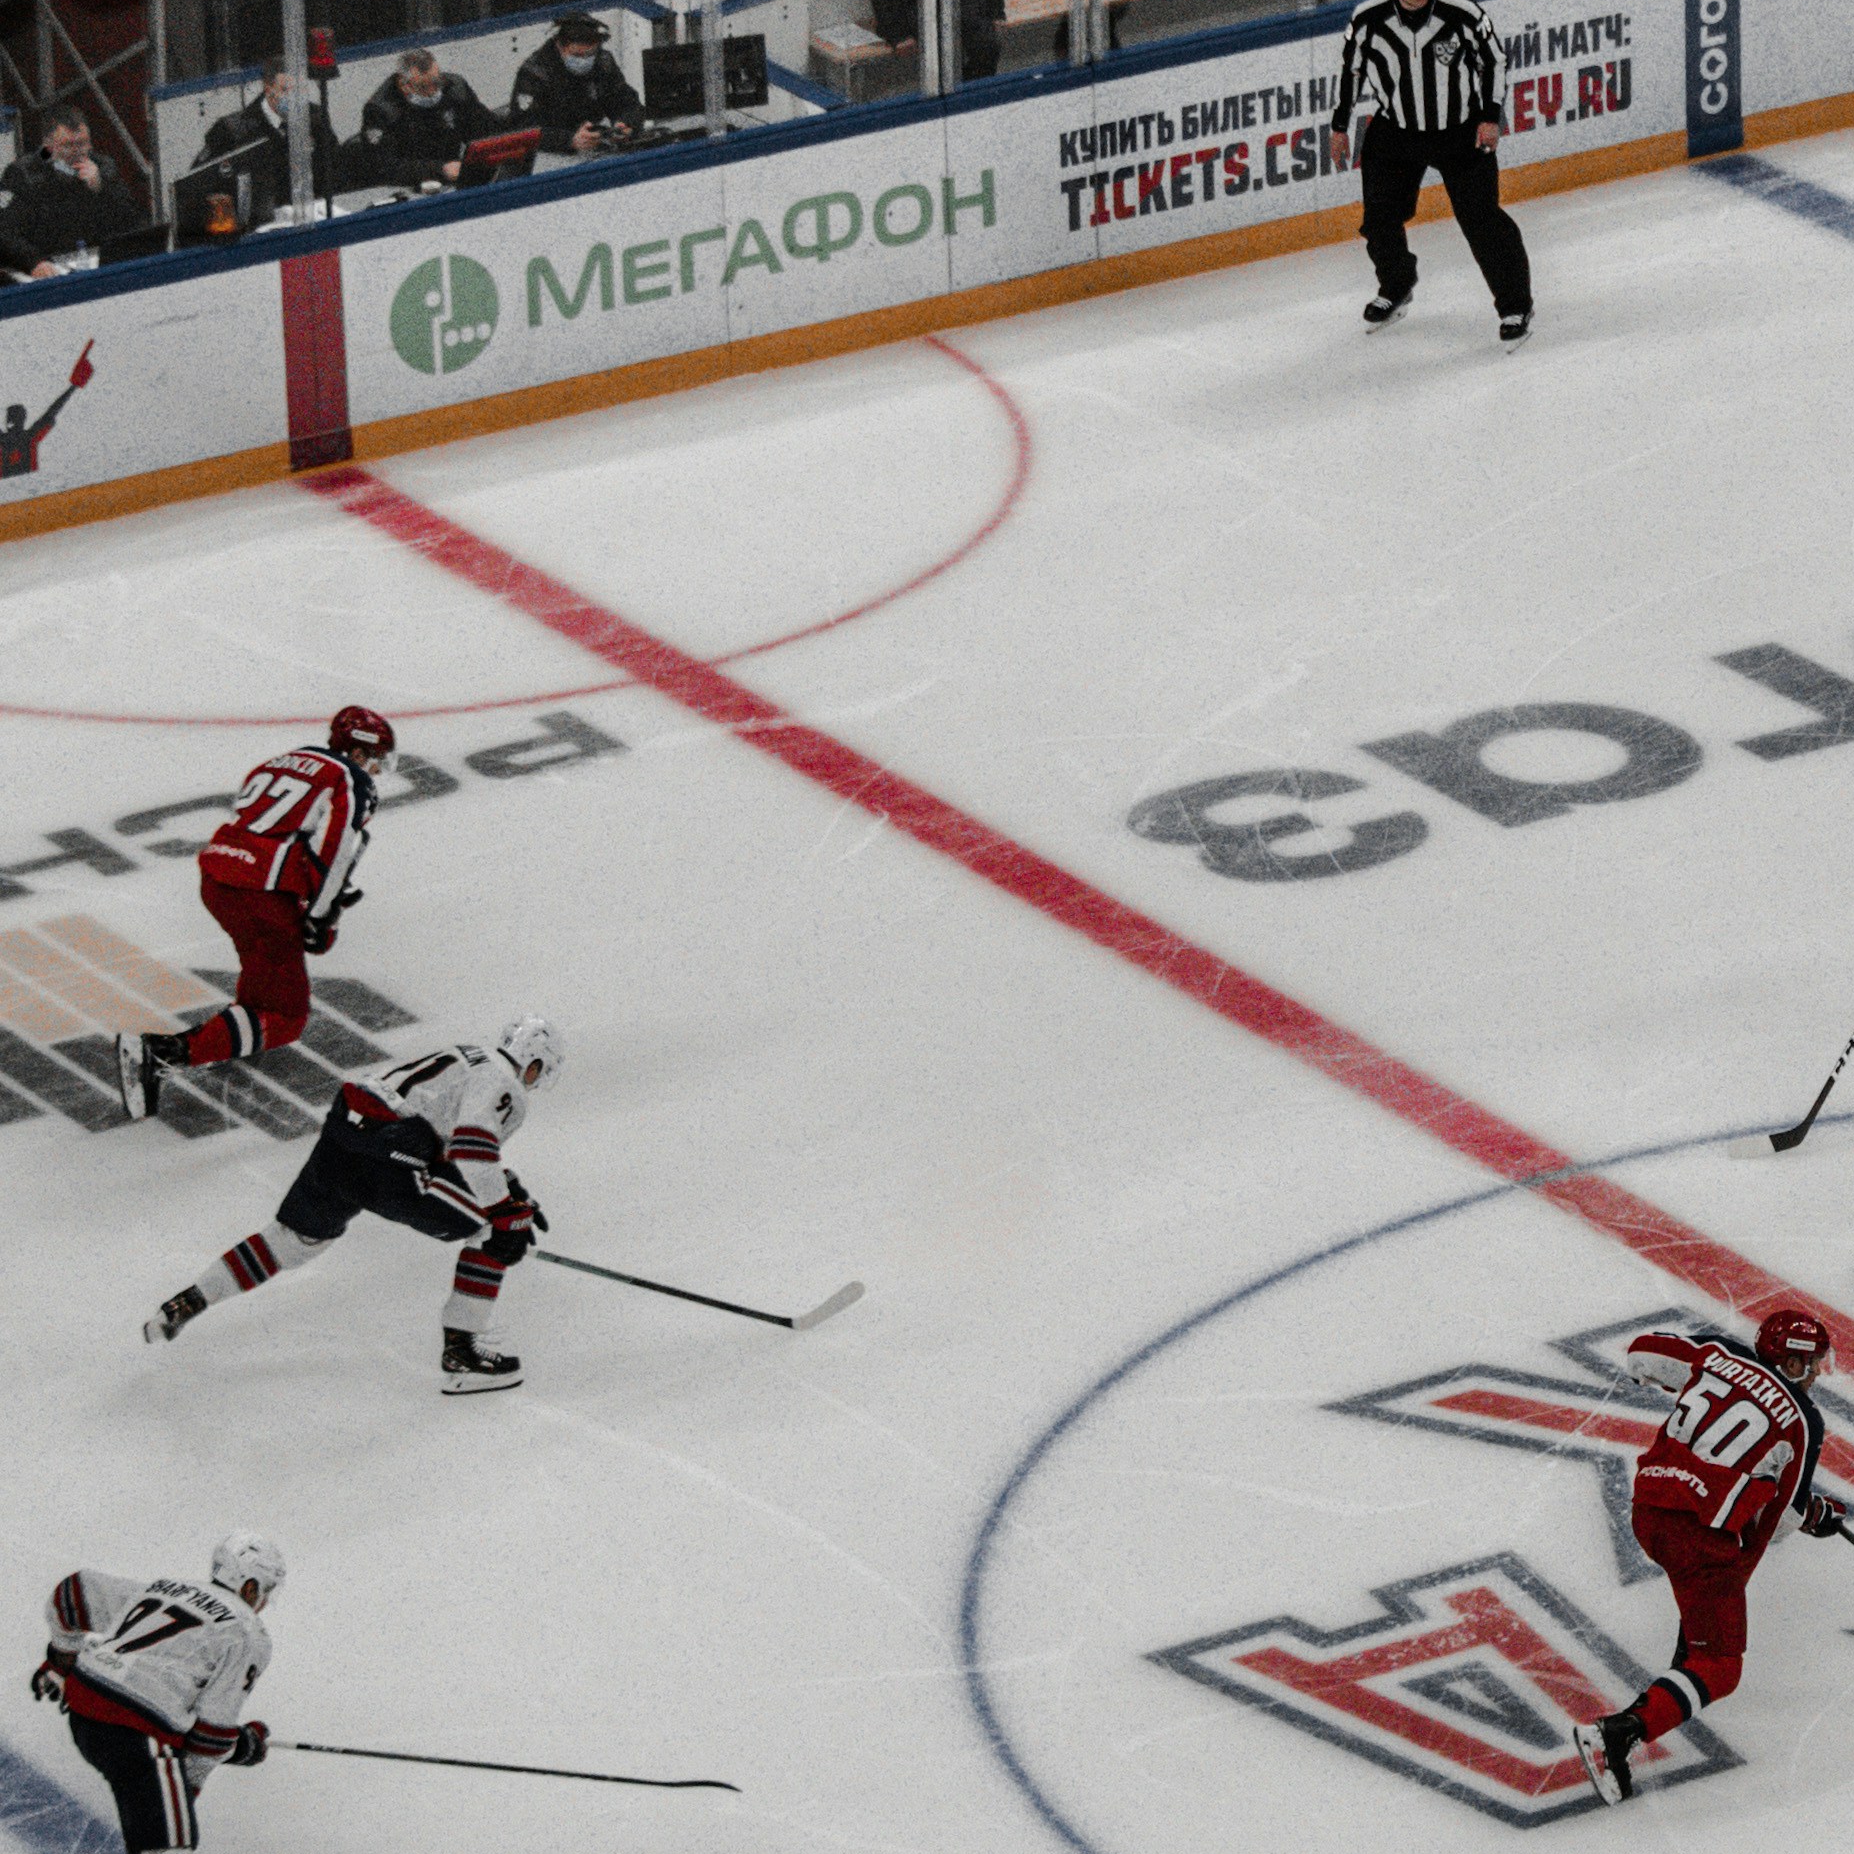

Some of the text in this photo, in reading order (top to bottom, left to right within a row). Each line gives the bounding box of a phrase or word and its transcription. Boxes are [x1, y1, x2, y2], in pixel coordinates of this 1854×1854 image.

[1059, 112, 1175, 169] КУПИТЬ
[1180, 83, 1303, 136] БИЛЕТЫ
[525, 168, 999, 329] МЕГАФОН
[234, 772, 313, 835] 27
[1666, 1370, 1771, 1469] 50
[1703, 1351, 1800, 1430] YURTAIKIN
